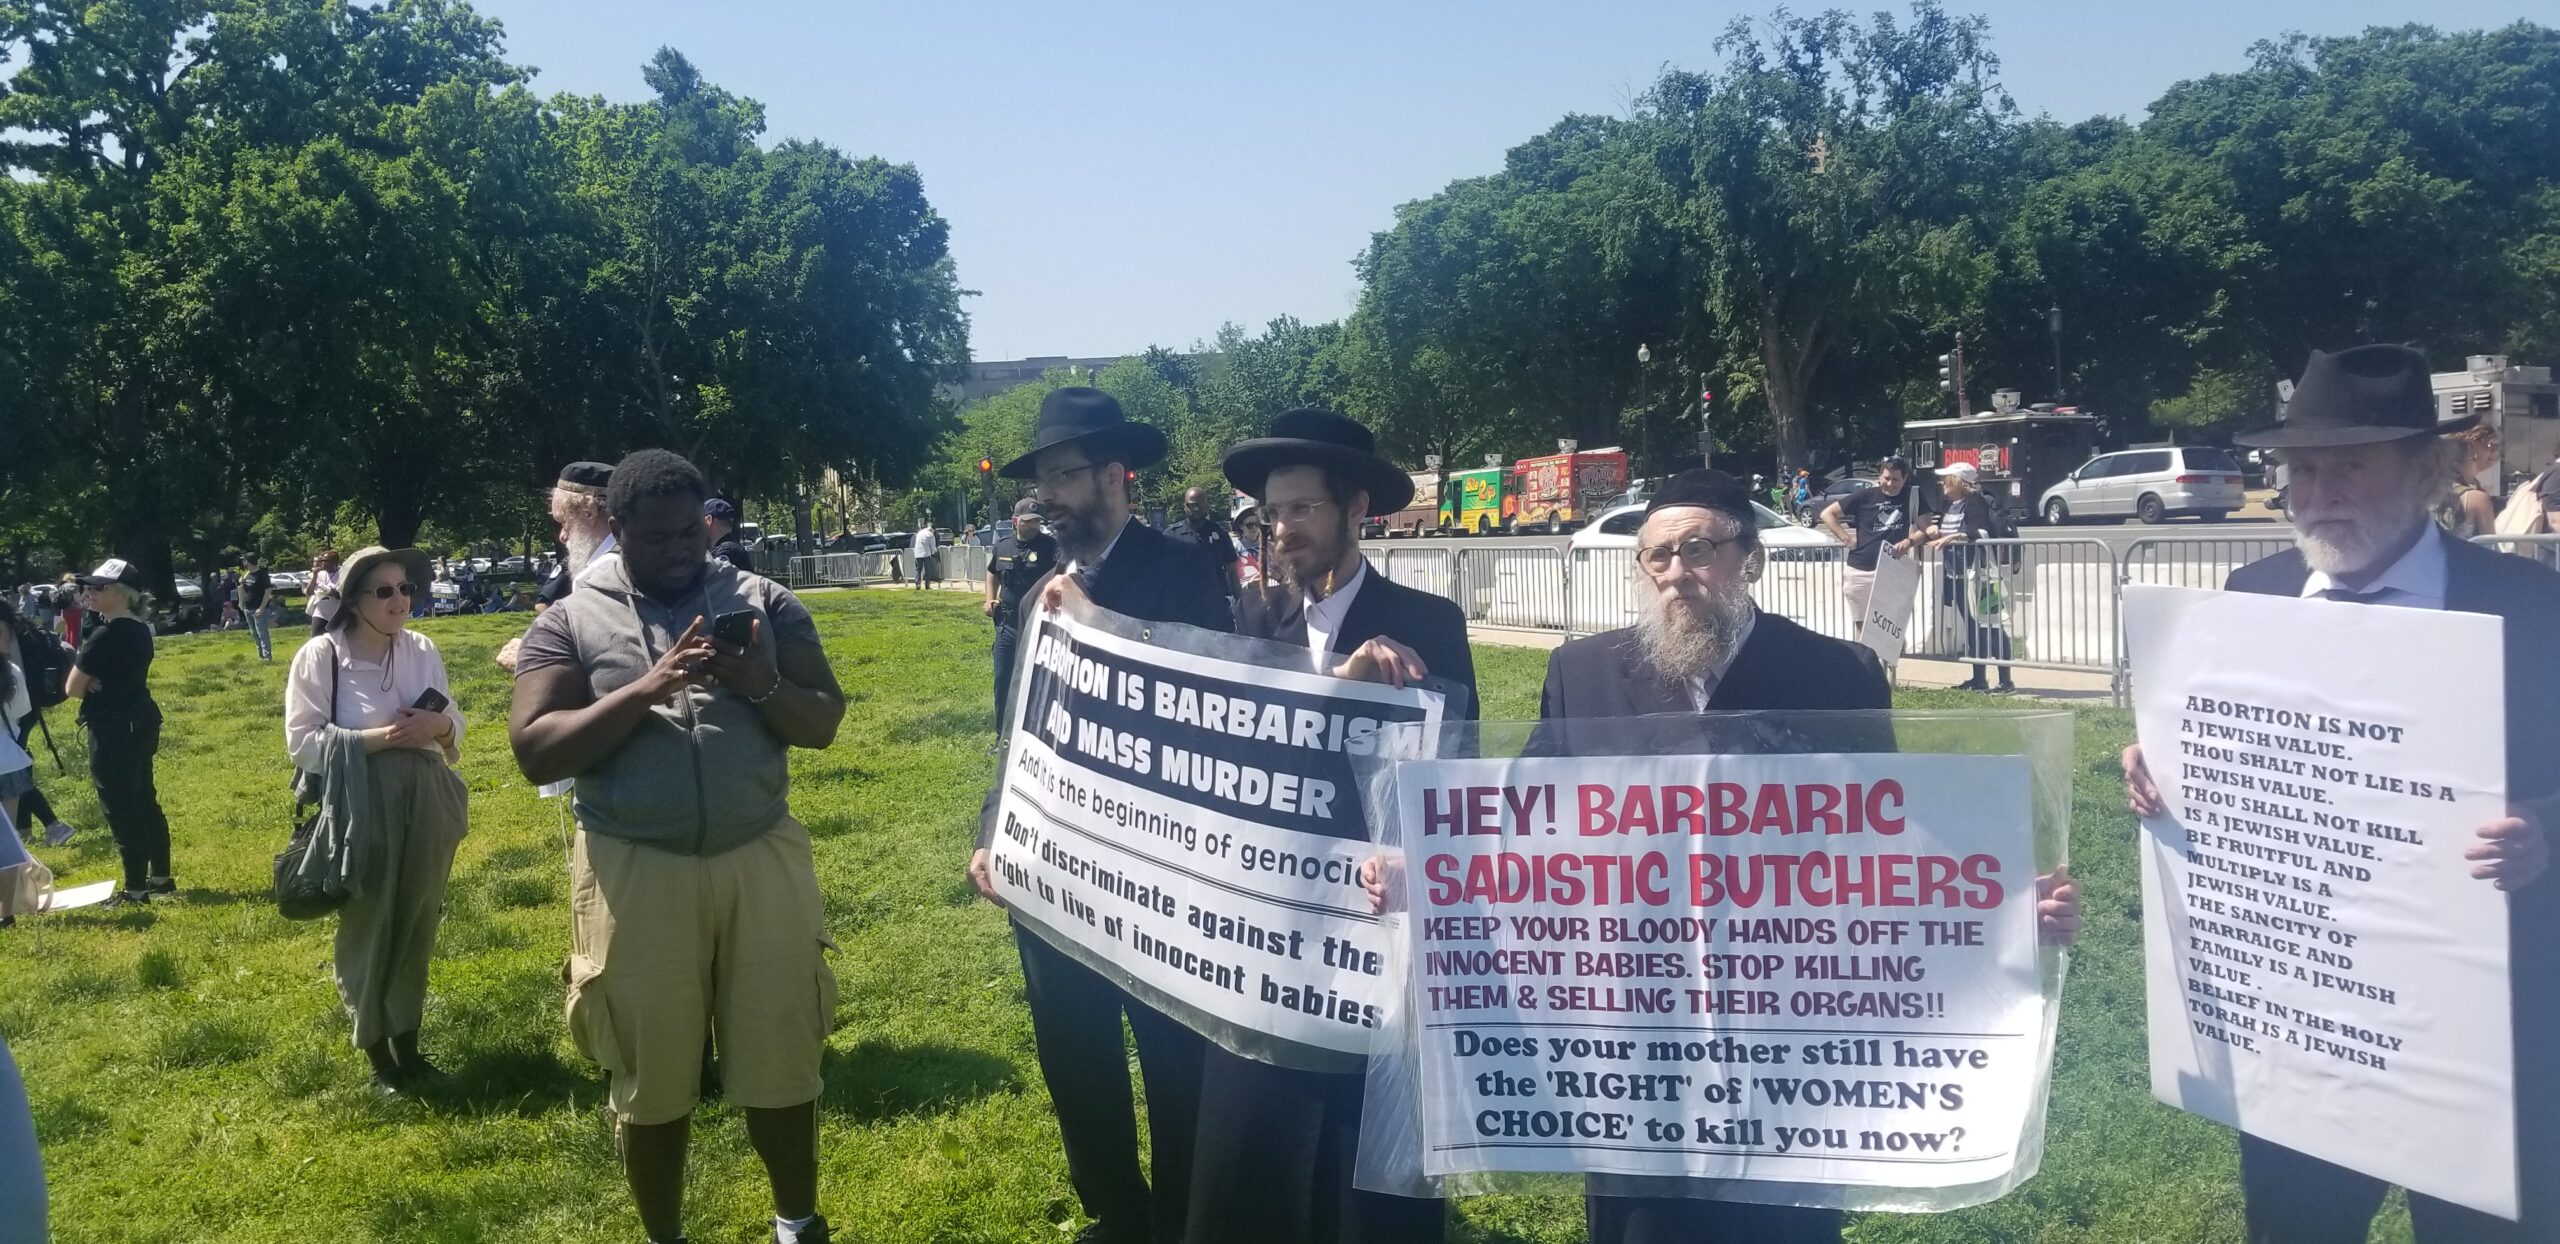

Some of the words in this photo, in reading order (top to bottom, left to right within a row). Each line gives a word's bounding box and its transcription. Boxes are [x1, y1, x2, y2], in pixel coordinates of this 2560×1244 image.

[1872, 610, 1901, 639] SCOTUS
[1118, 670, 1144, 711] IS
[1155, 681, 1421, 759] BARBARISM
[2181, 718, 2194, 733] A
[2198, 722, 2272, 748] JEWISH
[2274, 735, 2353, 760] VALUE.
[2186, 696, 2312, 730] ABORTION
[2318, 716, 2341, 734] IS
[2348, 720, 2404, 744] NOT
[1078, 718, 1151, 775] MASS
[1162, 745, 1336, 819] MURDER
[2181, 740, 2234, 762] THOU
[2240, 752, 2306, 776] SHALT
[2312, 764, 2358, 785] NOT
[2364, 773, 2403, 794] LIE
[2410, 781, 2432, 798] IS
[2439, 786, 2456, 802] A
[2183, 762, 2254, 790] JEWISH
[2258, 778, 2334, 804] VALUE.
[1018, 748, 1040, 778] And
[1048, 766, 1055, 793] is
[1060, 774, 1086, 808] the
[1092, 789, 1196, 852] beginning
[1206, 834, 1232, 858] of
[1424, 784, 1556, 836] HEY!
[1578, 778, 1906, 837] BARBARIC
[2182, 785, 2236, 808] THOU
[2241, 798, 2308, 824] SHALL
[2314, 811, 2360, 832] NOT
[2366, 822, 2424, 846] KILL
[2184, 806, 2202, 822] IS
[2207, 811, 2219, 826] A
[2224, 815, 2300, 844] JEWISH
[2304, 832, 2383, 862] VALUE.
[2186, 828, 2211, 845] BE
[2216, 836, 2318, 871] FRUITFUL
[2324, 860, 2372, 882] AND
[1004, 811, 1038, 854] Don't
[1042, 840, 1176, 918] discriminate
[1188, 904, 1304, 960] against
[1323, 936, 1384, 976] the
[1425, 851, 1670, 906] SADISTIC
[1689, 851, 2004, 909] BUTCHERS
[2188, 850, 2286, 886] MULTIPLY
[2292, 876, 2312, 892] IS
[2318, 882, 2334, 898] A
[2188, 872, 2259, 903] JEWISH
[2262, 891, 2338, 922] VALUE.
[995, 853, 1031, 892] right
[1037, 876, 1055, 905] to
[1062, 888, 1096, 928] live
[1104, 915, 1123, 941] of
[1134, 924, 1246, 995] innocent
[1260, 973, 1384, 1030] babies
[1424, 916, 1501, 941] KEEP
[1510, 916, 1590, 942] YOUR
[1600, 916, 1718, 944] BLOODY
[1729, 918, 1838, 944] HANDS
[1848, 920, 1910, 946] OFF
[1919, 920, 1984, 946] THE
[2187, 894, 2226, 916] THE
[2231, 906, 2322, 940] SANCITY
[2328, 930, 2358, 948] OF
[2188, 916, 2300, 957] MARRAIGE
[2306, 947, 2354, 970] AND
[1426, 950, 1566, 976] INNOCENT
[1576, 952, 1693, 979] BABIES.
[1702, 954, 1784, 980] STOP
[1795, 955, 1926, 982] KILLING
[2190, 936, 2264, 968] FAMILY
[2270, 959, 2288, 976] IS
[2294, 966, 2308, 982] A
[2312, 970, 2396, 1005] JEWISH
[1428, 985, 1508, 1012] THEM
[1518, 986, 1538, 1011] &
[1546, 986, 1676, 1014] SELLING
[1685, 989, 1780, 1016] THEIR
[1790, 991, 1944, 1018] ORGANS!!
[2188, 978, 2260, 1010] BELIEF
[2265, 1000, 2288, 1019] IN
[2292, 1008, 2335, 1033] THE
[2341, 1024, 2403, 1052] HOLY
[1454, 1030, 1539, 1057] Does
[1548, 1037, 1636, 1063] your
[1646, 1036, 1792, 1064] mother
[1802, 1038, 1882, 1066] still
[1892, 1040, 1989, 1070] have
[2188, 998, 2256, 1032] TORAH
[2262, 1022, 2280, 1039] IS
[2286, 1030, 2300, 1045] A
[2305, 1034, 2386, 1071] JEWISH
[2193, 1020, 2261, 1054] VALUE.
[1476, 1070, 1536, 1096] the
[1547, 1070, 1692, 1101] 'RIGHT'
[1704, 1078, 1742, 1104] of
[1753, 1078, 1964, 1111] 'WOMEN'S
[1476, 1110, 1634, 1140] CHOICE'
[1644, 1118, 1685, 1142] to
[1695, 1117, 1765, 1146] kill
[1774, 1126, 1848, 1153] you
[1860, 1126, 1966, 1153] now?
